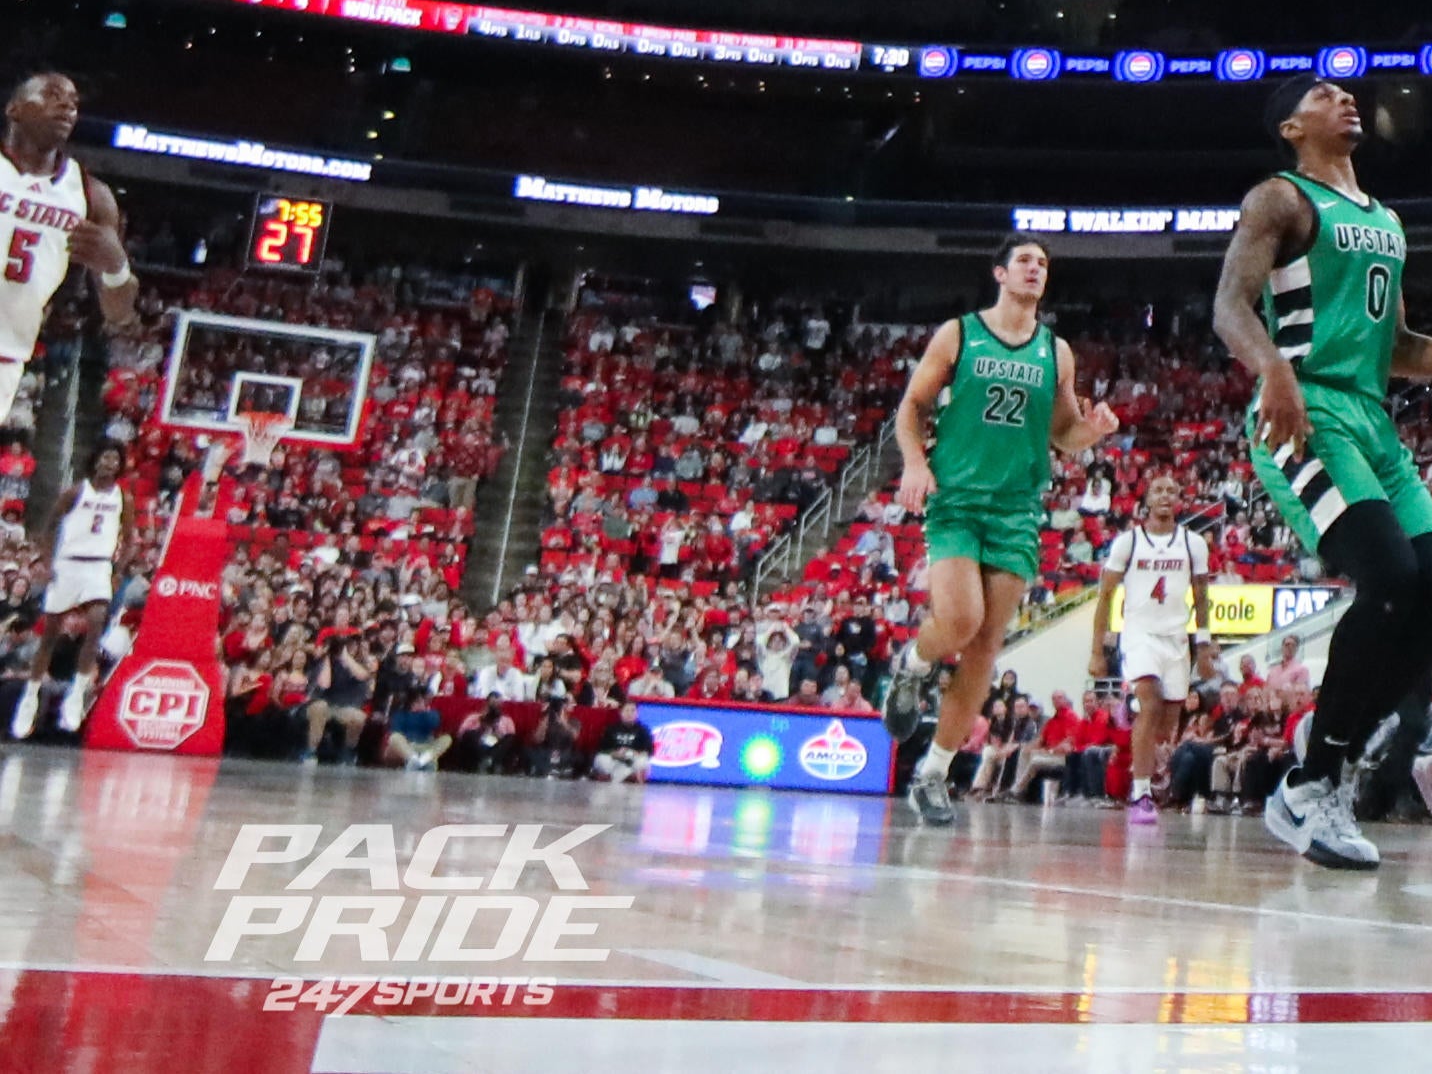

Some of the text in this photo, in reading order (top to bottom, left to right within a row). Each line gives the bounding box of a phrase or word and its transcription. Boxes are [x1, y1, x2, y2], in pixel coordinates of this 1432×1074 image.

[963, 57, 1007, 70] PEPSI
[1066, 58, 1110, 72] PEPSI
[1169, 60, 1212, 73] PEPSI
[1270, 57, 1312, 70] PEPSI
[1372, 54, 1415, 67] PEPSI
[0, 191, 14, 213] C
[278, 198, 323, 228] 7:55
[1013, 208, 1066, 230] THE
[1175, 209, 1241, 232] MAN'
[257, 221, 315, 264] 27
[1335, 223, 1407, 263] UPSTAT
[4, 227, 42, 284] 5
[1366, 263, 1391, 323] 0
[974, 356, 1044, 388] UPSTATE
[982, 383, 1028, 427] 22
[1136, 559, 1184, 571] NC STATE
[178, 579, 218, 600] PNC
[1150, 576, 1168, 605] 4
[129, 691, 202, 719] CPI
[804, 752, 863, 763] AMOCO
